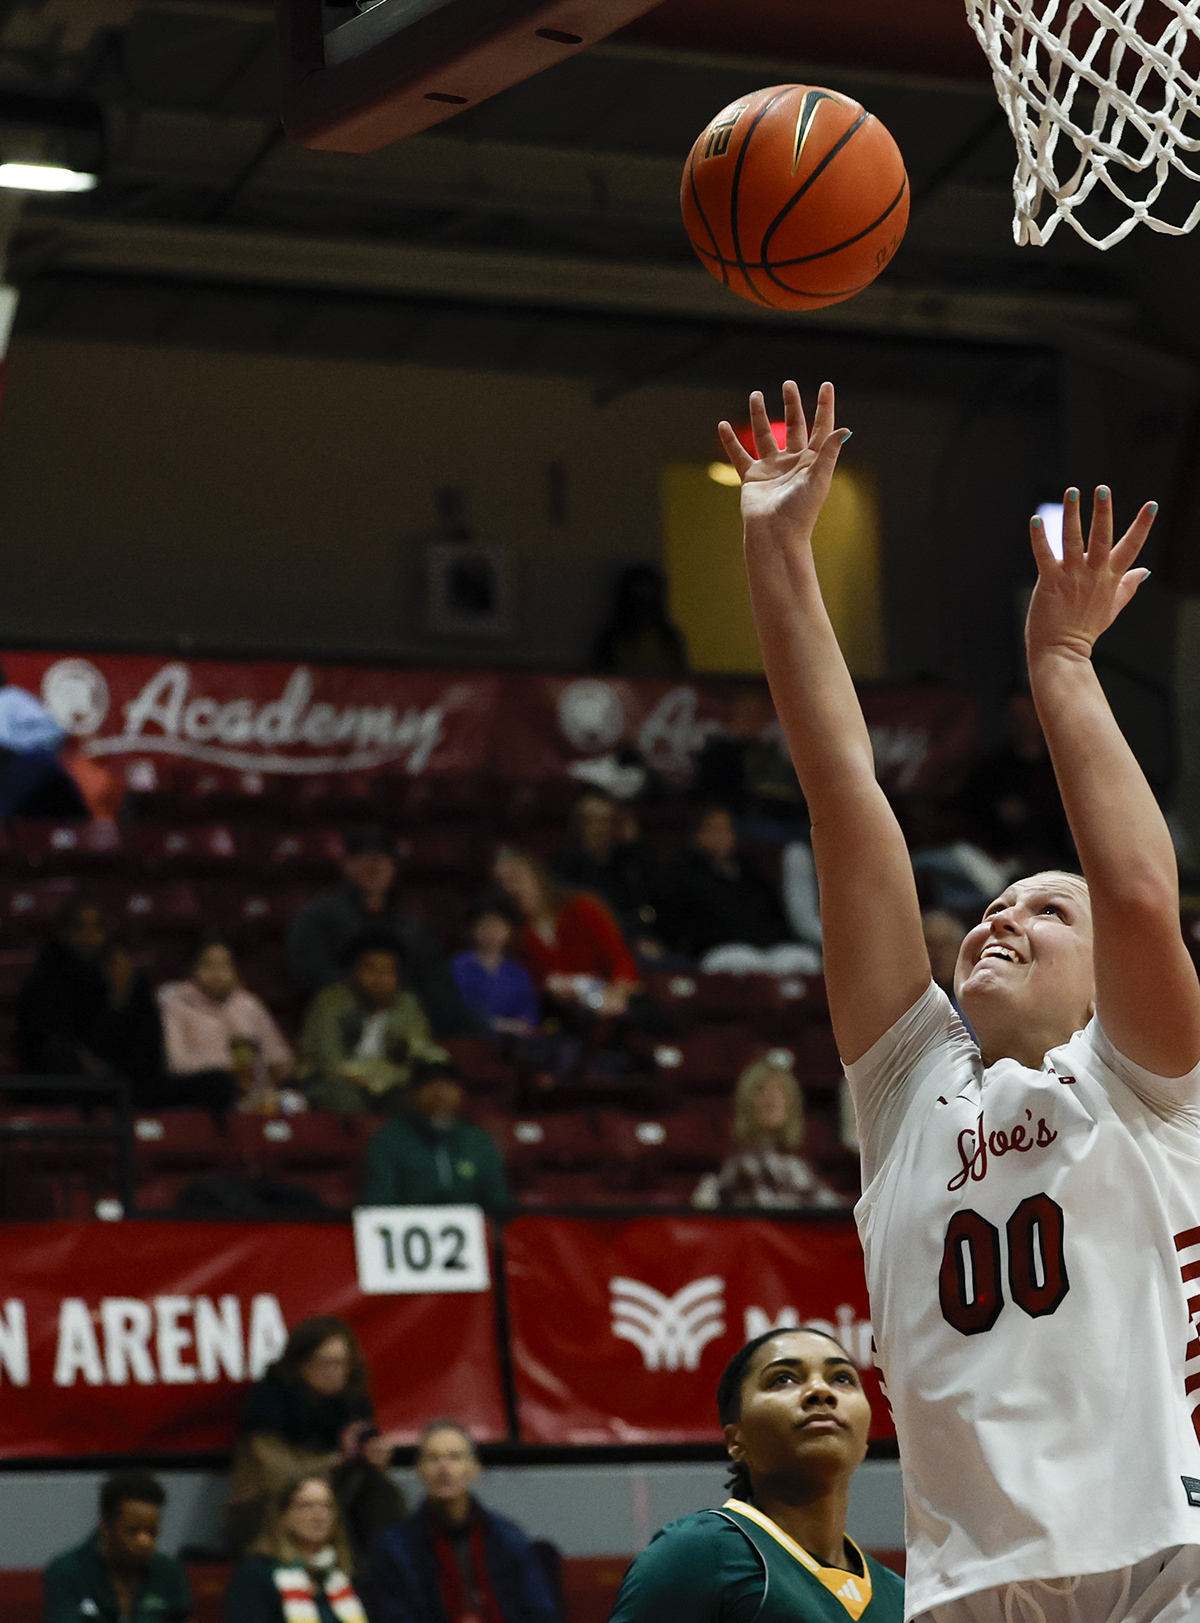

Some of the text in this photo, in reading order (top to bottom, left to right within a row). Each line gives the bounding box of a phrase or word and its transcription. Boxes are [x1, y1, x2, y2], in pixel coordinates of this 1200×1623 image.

[122, 661, 446, 775] Academy
[376, 1226, 467, 1272] 102
[939, 1192, 1070, 1336] 00
[54, 1293, 289, 1386] ARENA
